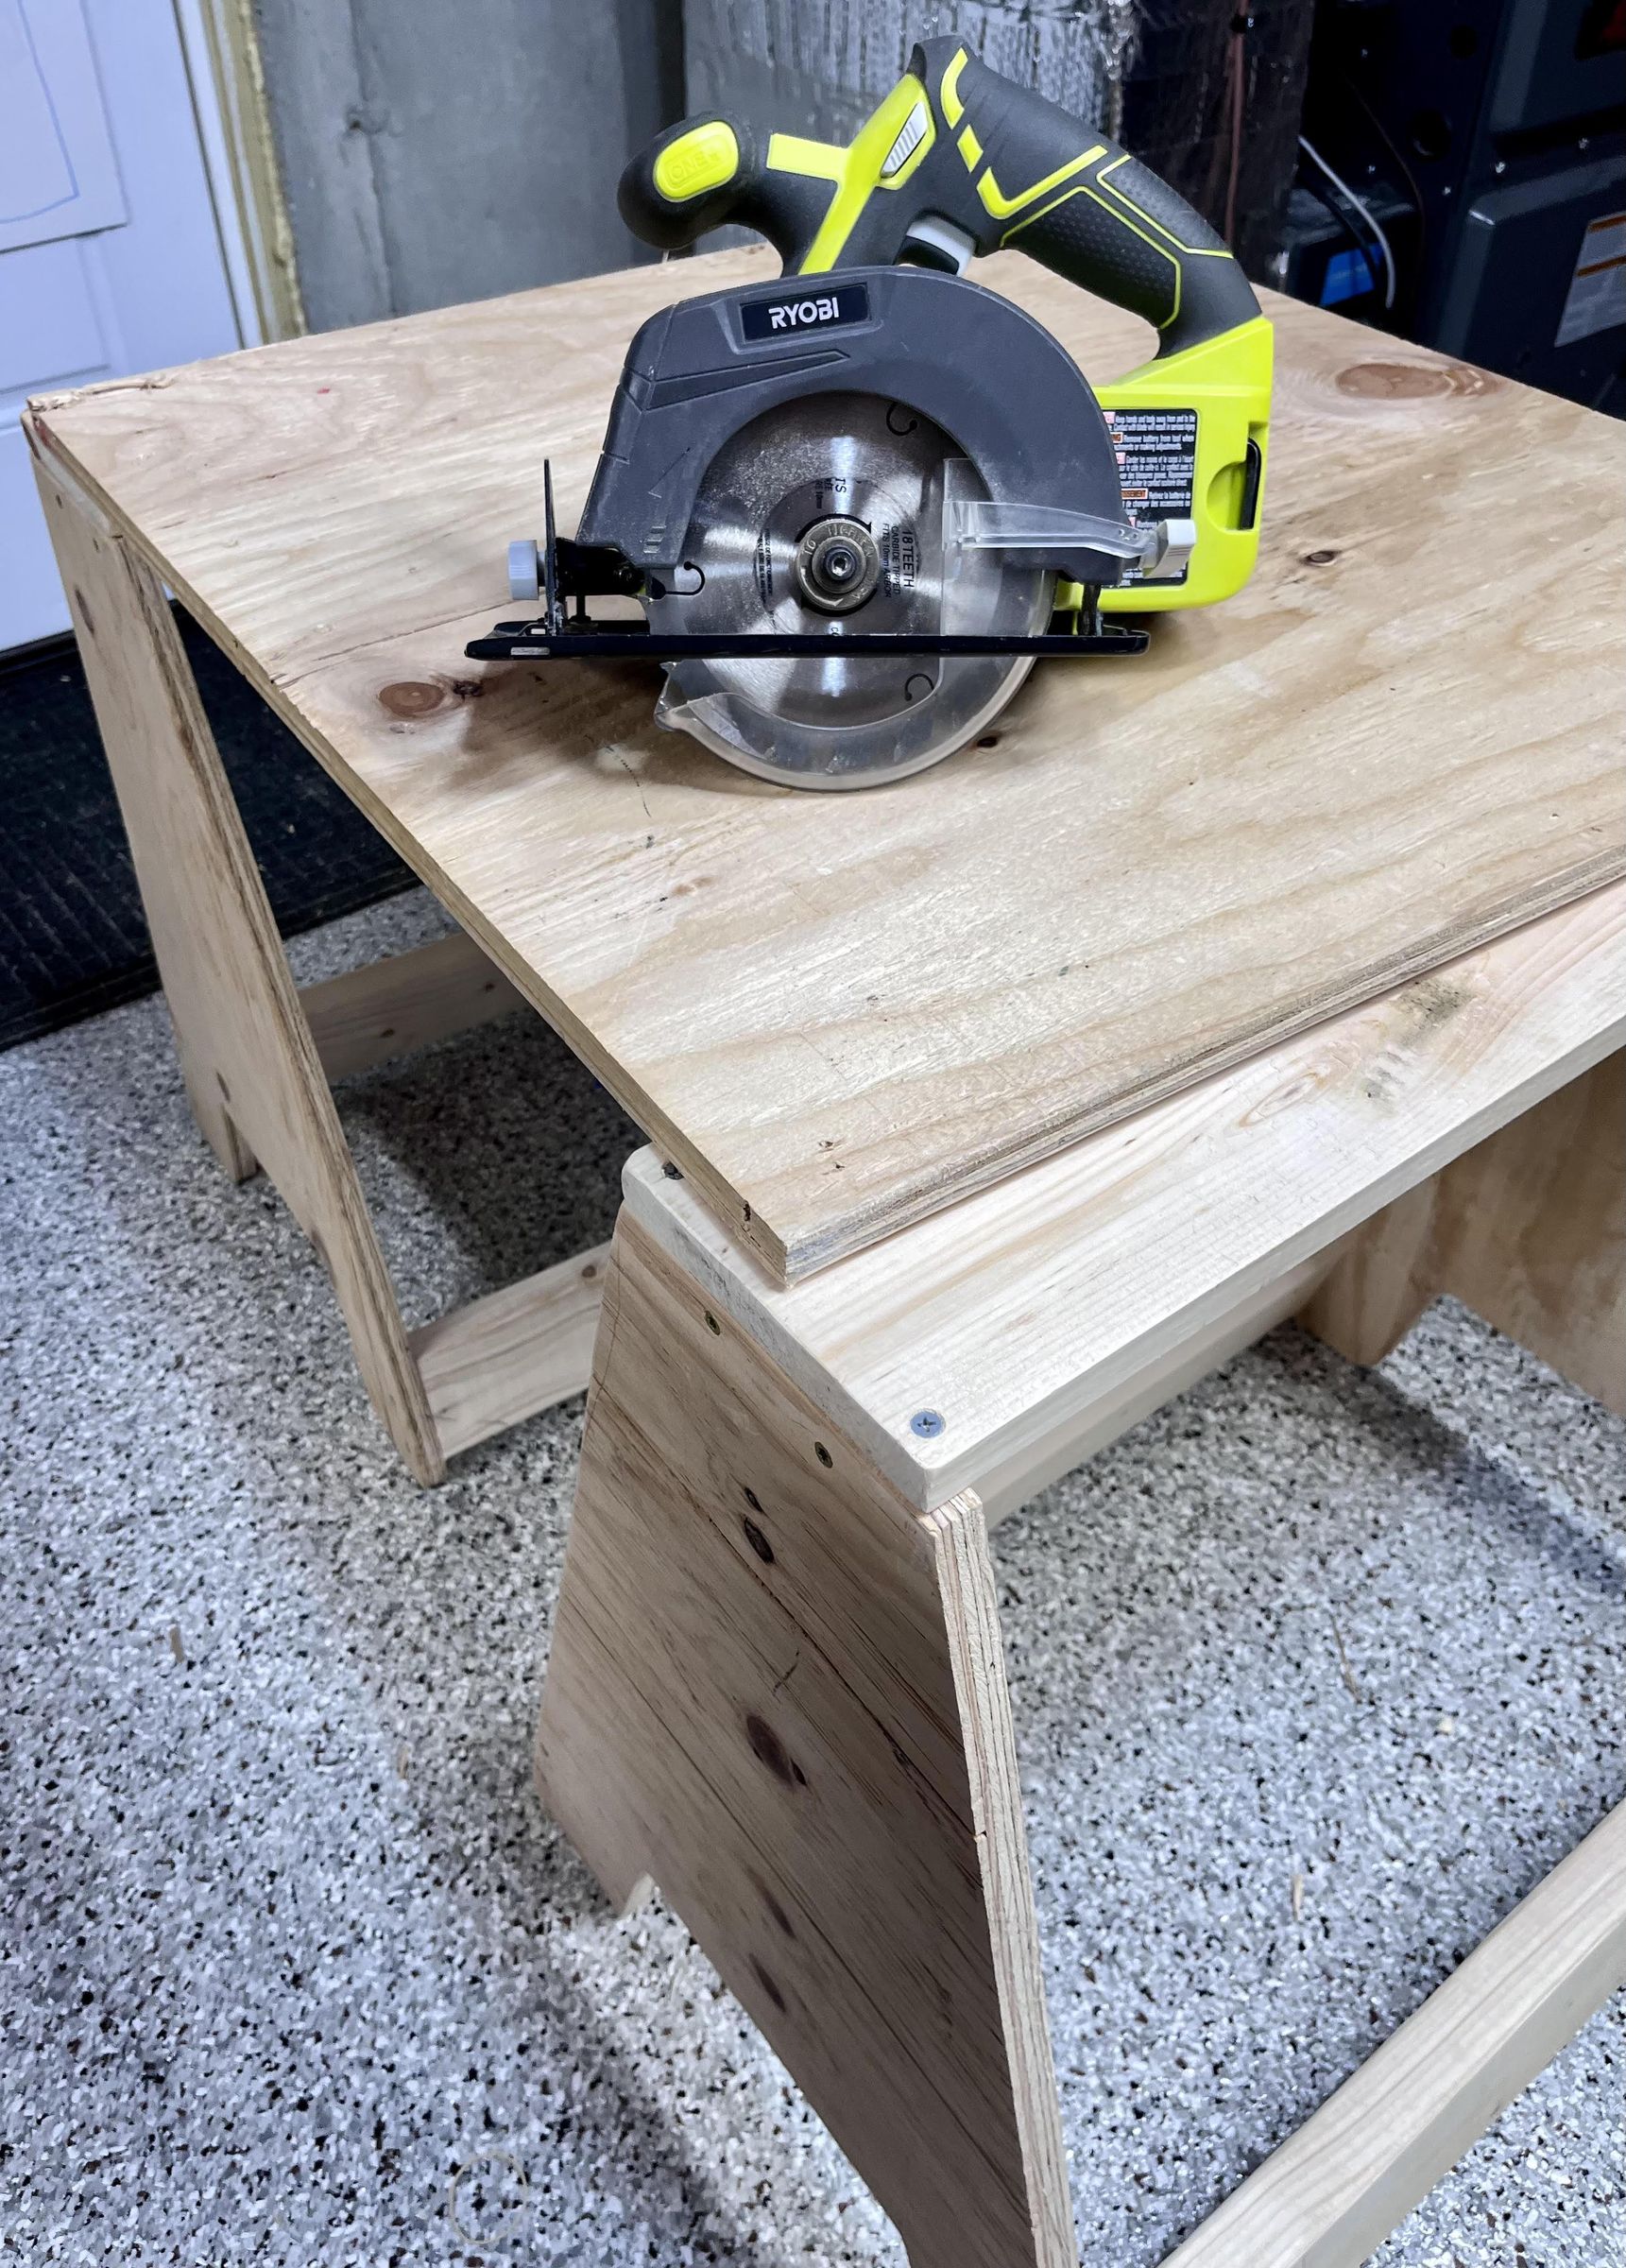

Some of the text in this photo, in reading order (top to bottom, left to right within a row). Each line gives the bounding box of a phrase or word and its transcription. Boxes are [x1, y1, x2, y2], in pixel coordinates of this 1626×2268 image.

[768, 297, 839, 329] RYOBI
[892, 525, 901, 595] CARBIDE TIPPED
[901, 530, 915, 588] 18 TEETH
